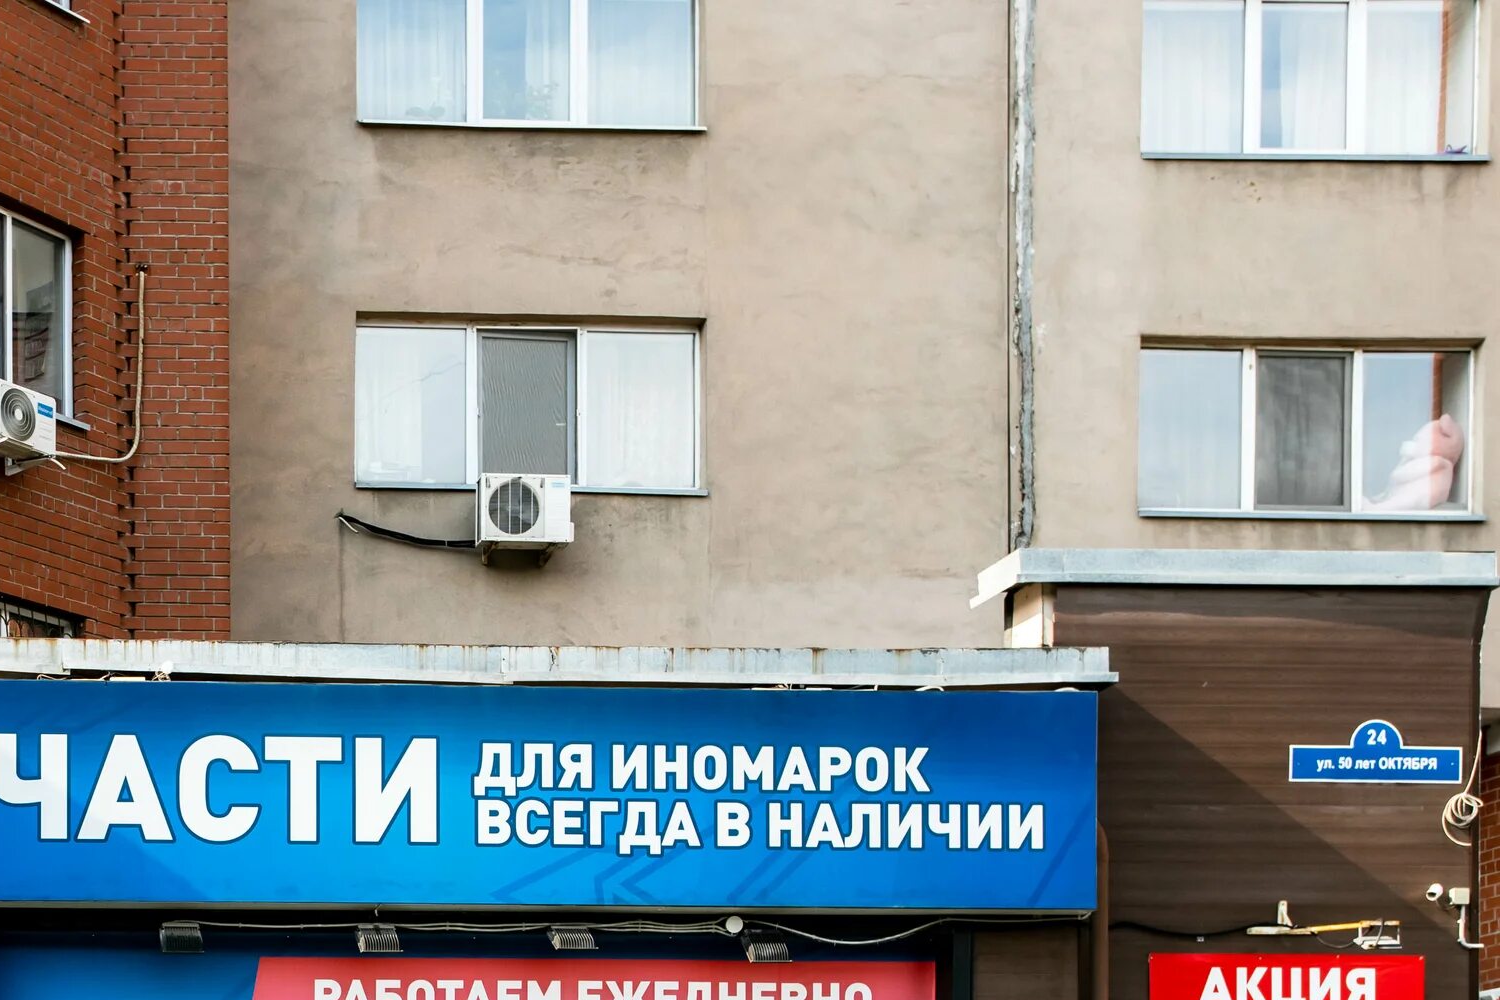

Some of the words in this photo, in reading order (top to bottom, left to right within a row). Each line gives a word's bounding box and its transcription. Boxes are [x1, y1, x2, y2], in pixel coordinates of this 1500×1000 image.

[1366, 729, 1388, 746] 24
[473, 741, 593, 796] ДЛЯ
[612, 744, 931, 793] ИНОМАРОК
[1316, 758, 1335, 773] ул.
[1338, 756, 1352, 770] 50
[1355, 760, 1376, 770] лет
[1378, 757, 1438, 770] ОКТЯБРЯ
[476, 800, 702, 856] ВСЕГДА
[717, 802, 751, 847] В
[769, 803, 1045, 850] НАЛИЧИИ
